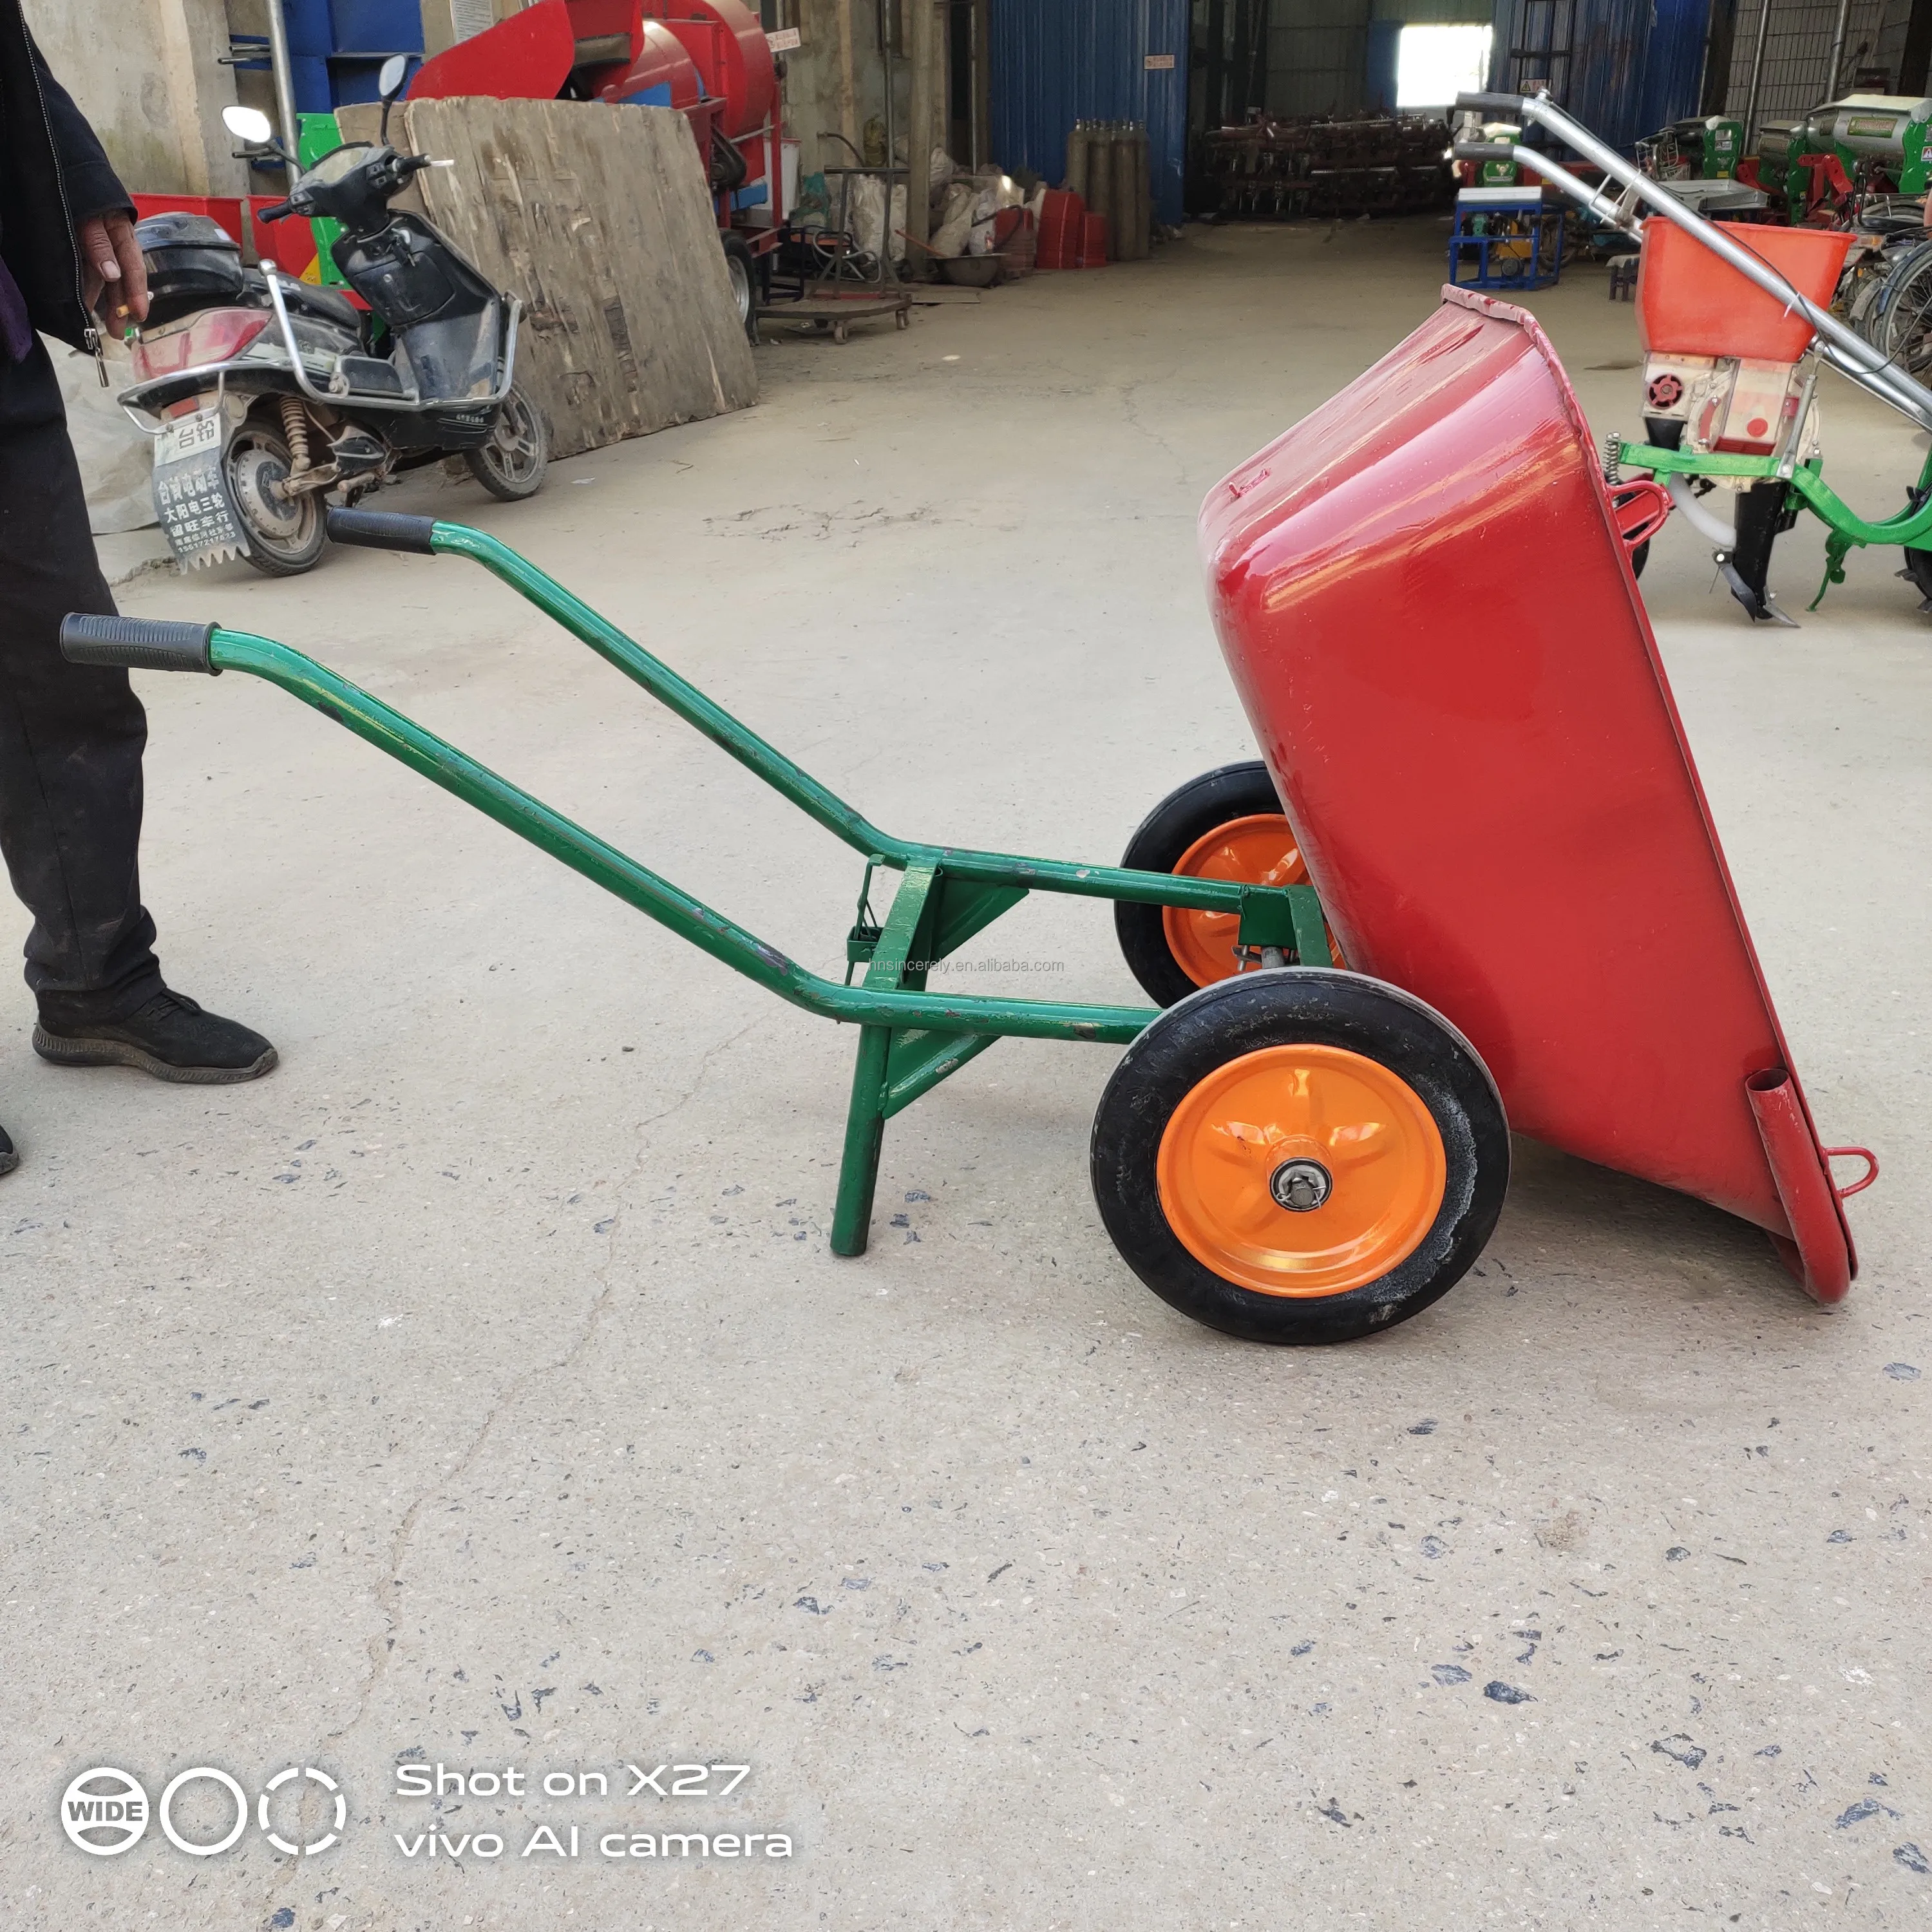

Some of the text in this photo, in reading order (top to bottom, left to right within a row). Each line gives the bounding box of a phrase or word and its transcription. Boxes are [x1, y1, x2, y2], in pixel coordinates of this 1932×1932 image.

[164, 492, 225, 523] 大阳电三轮
